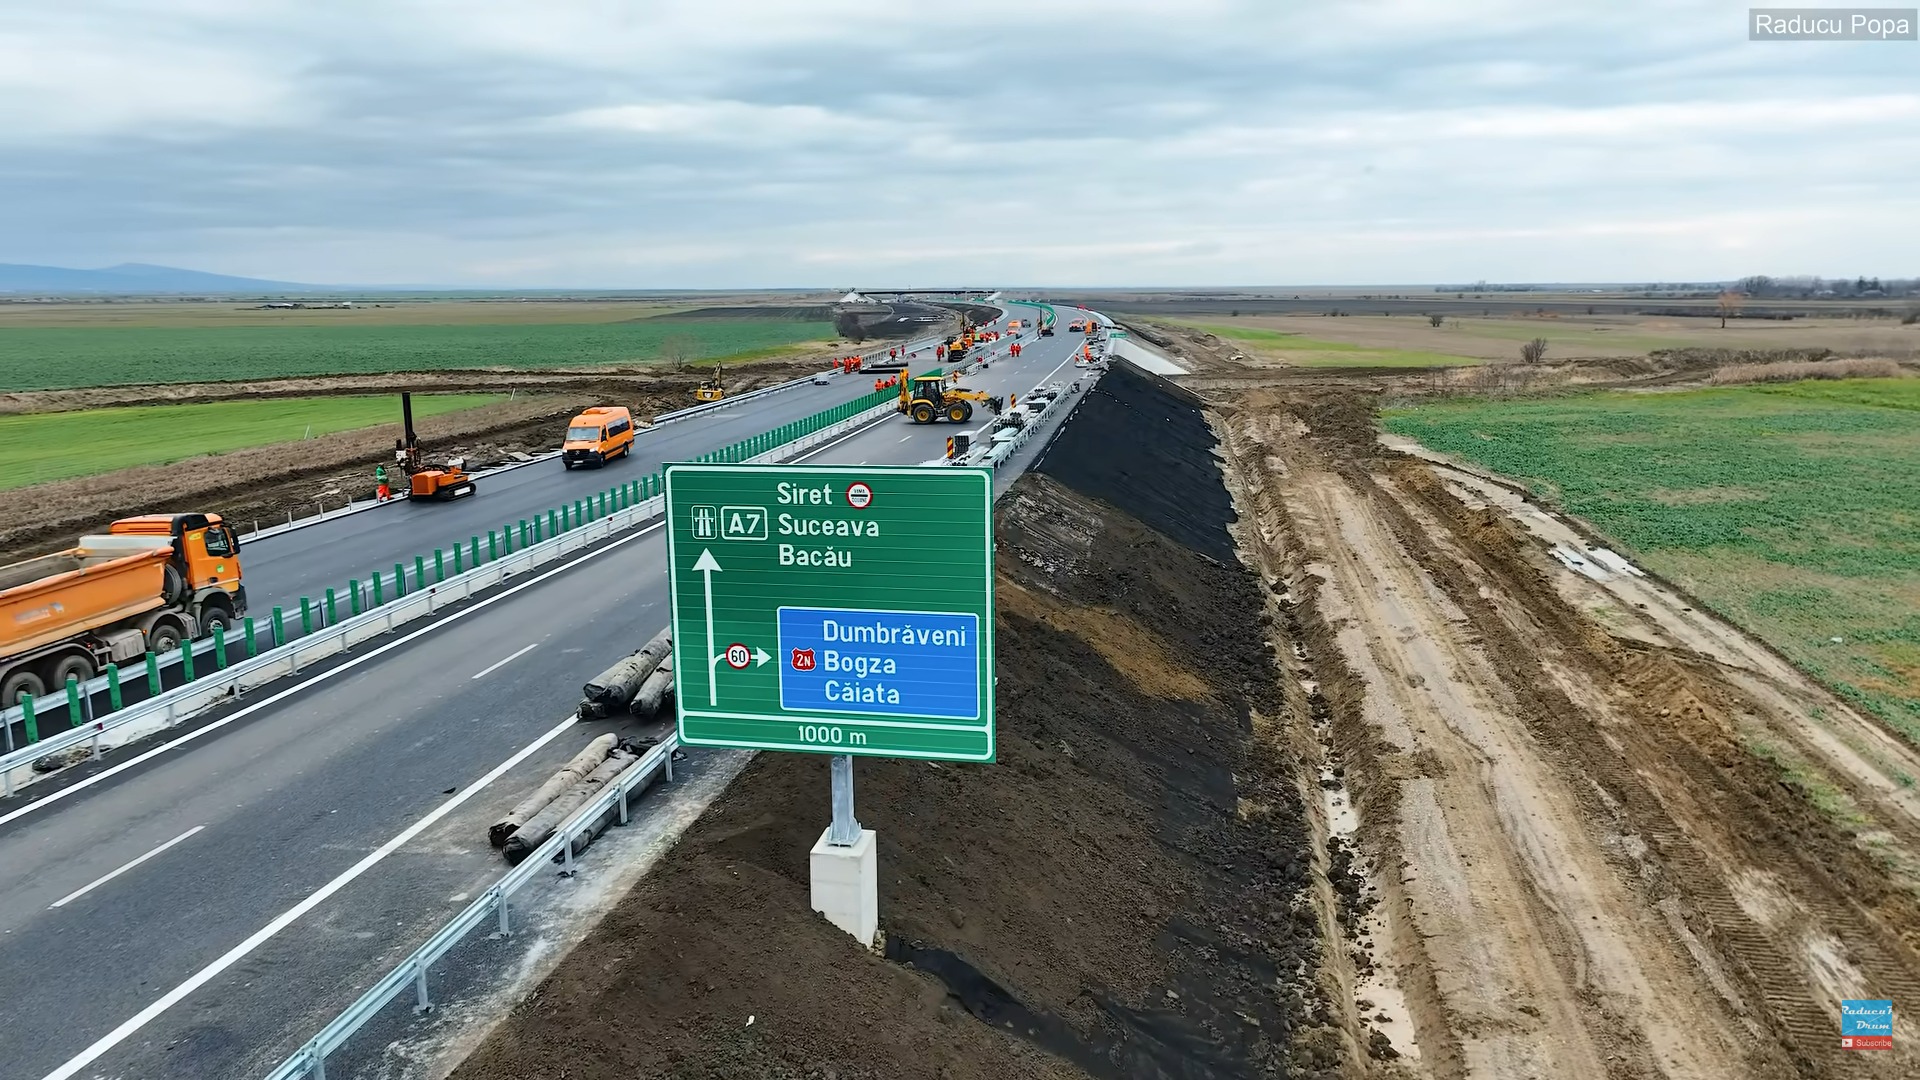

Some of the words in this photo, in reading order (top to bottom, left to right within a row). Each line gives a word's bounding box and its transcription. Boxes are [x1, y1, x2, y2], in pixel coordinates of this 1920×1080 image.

[776, 482, 833, 506] Siret
[728, 512, 761, 534] A7
[777, 513, 880, 537] Suceava
[778, 544, 852, 567] Bacău
[822, 620, 967, 647] Dumbrăveni
[731, 649, 746, 663] 60
[796, 653, 811, 667] 2N
[823, 650, 897, 679] Bogza
[824, 680, 900, 705] Căiata
[797, 725, 843, 745] 1000
[849, 730, 867, 746] m
